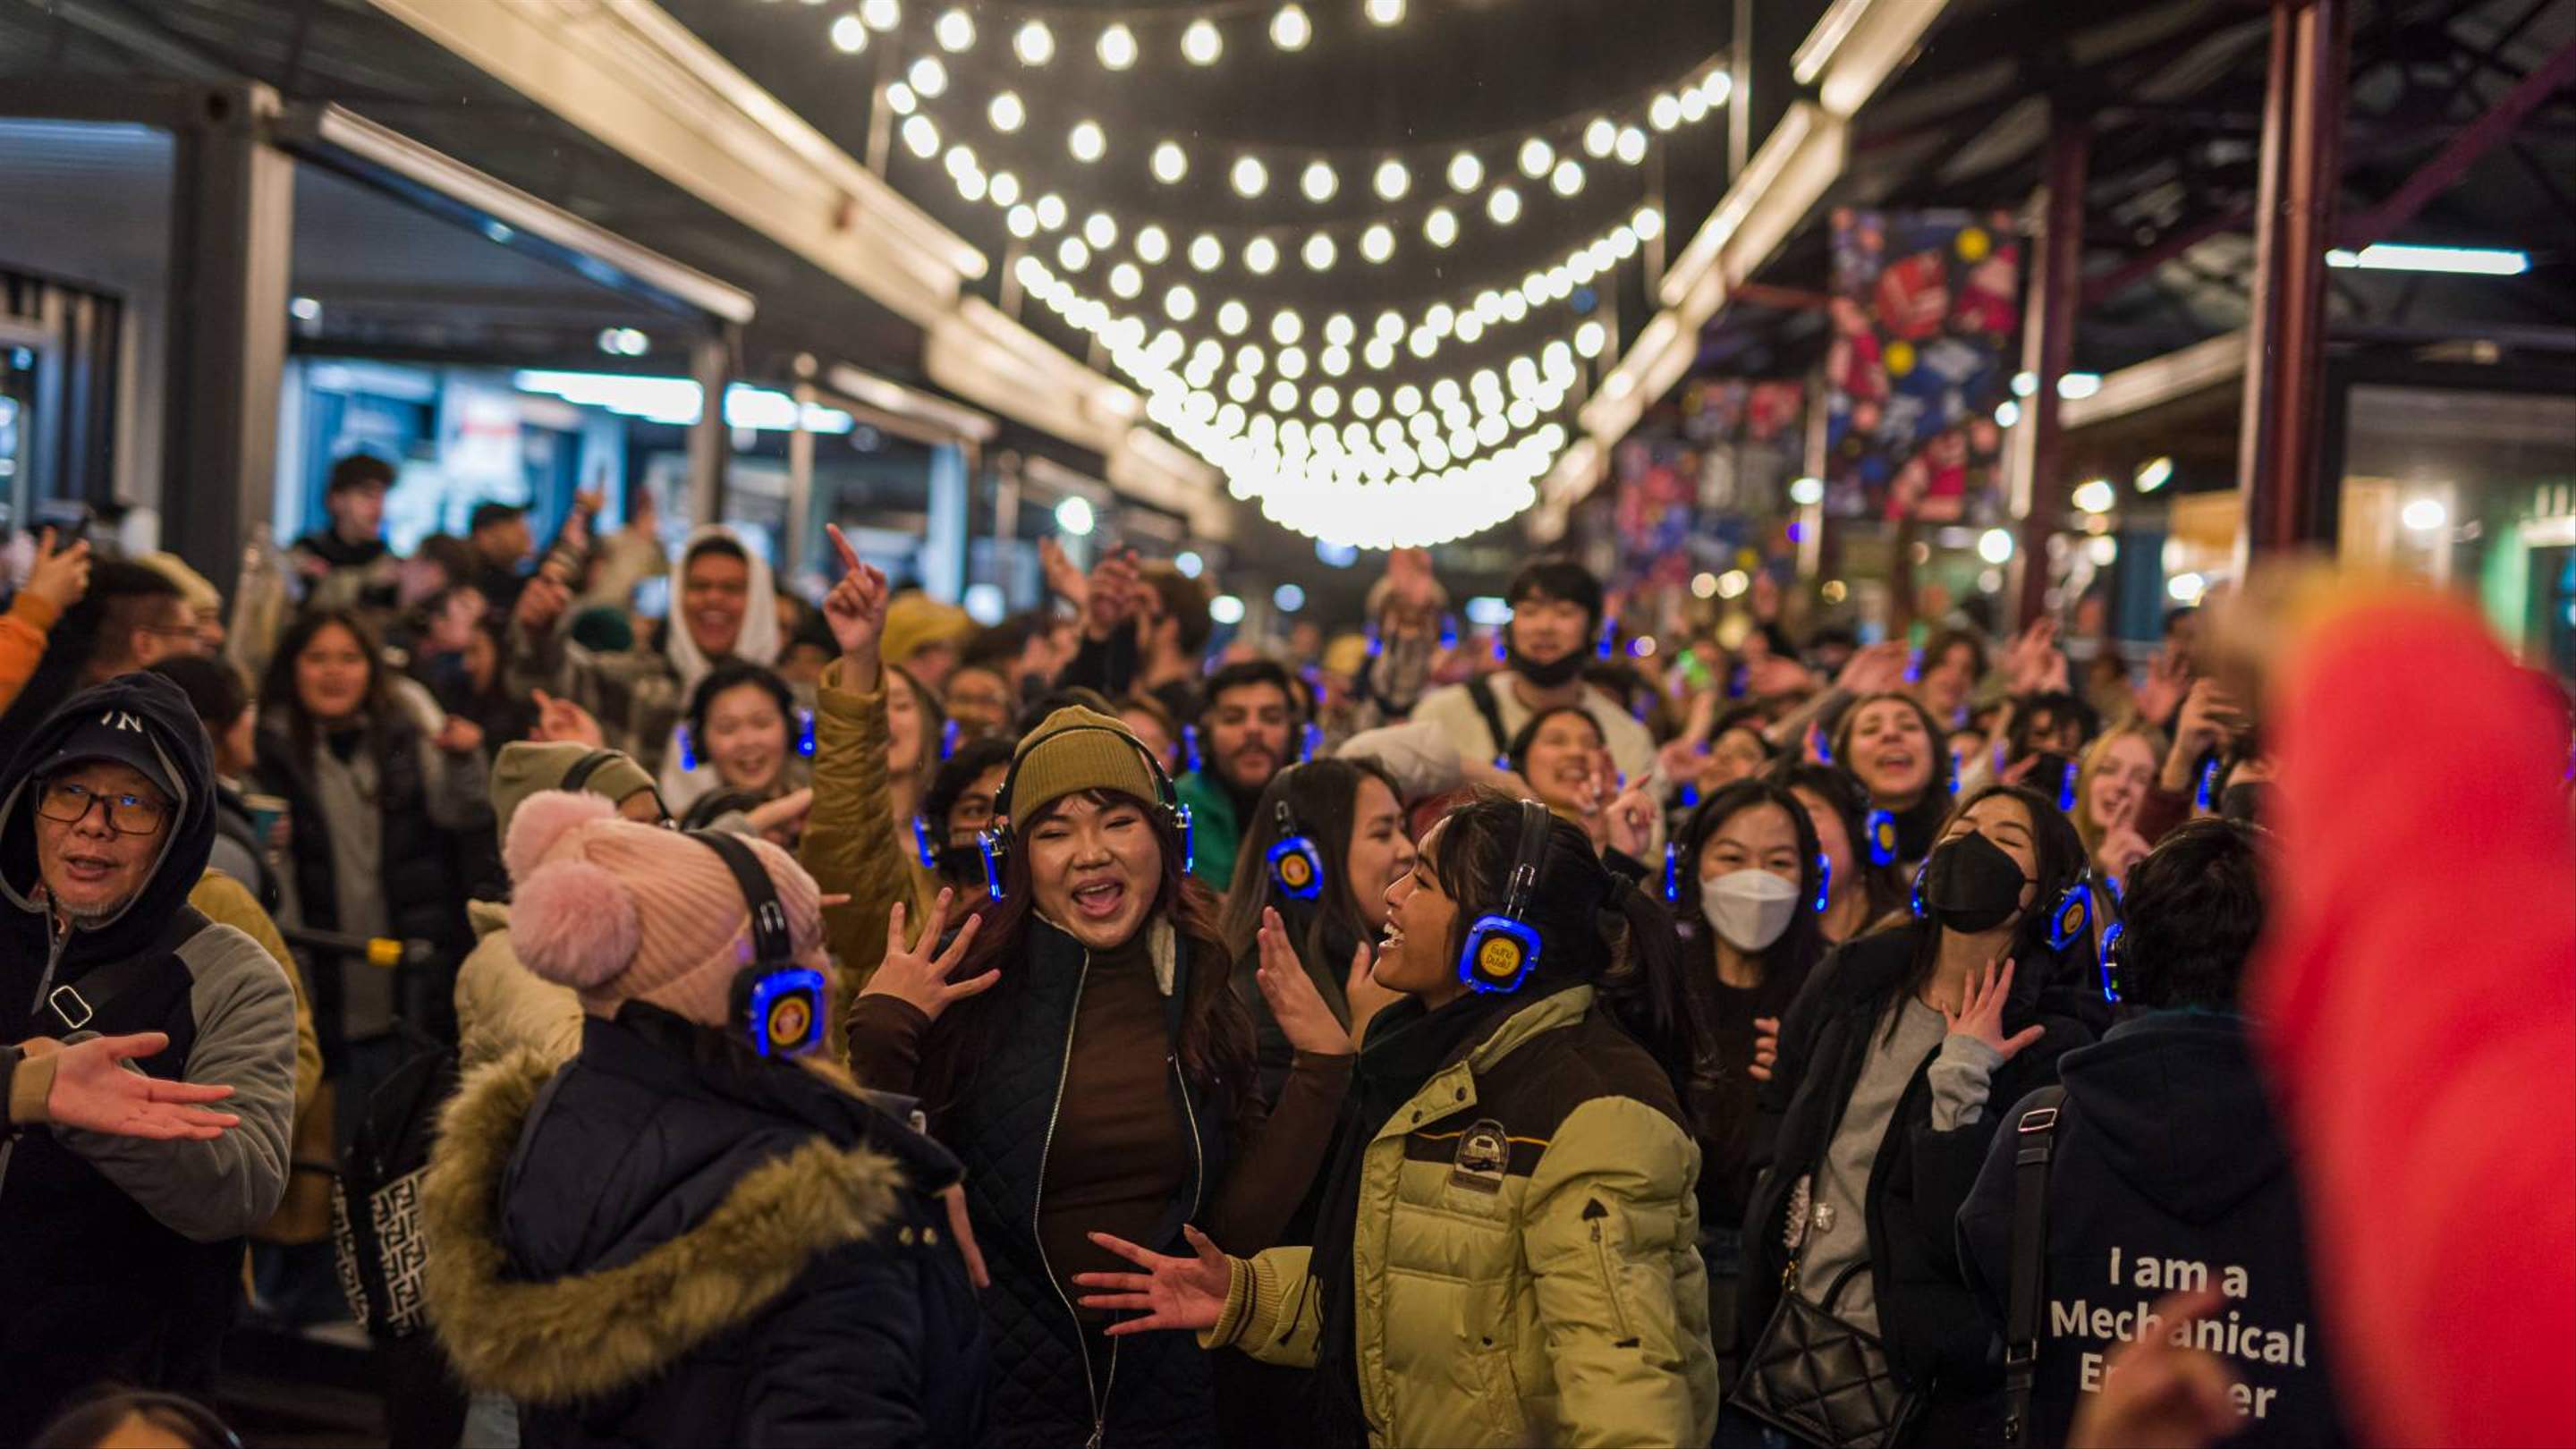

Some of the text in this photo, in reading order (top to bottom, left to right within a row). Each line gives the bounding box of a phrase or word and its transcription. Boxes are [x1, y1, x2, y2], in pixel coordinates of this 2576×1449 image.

[2110, 1247, 2248, 1299] I am a
